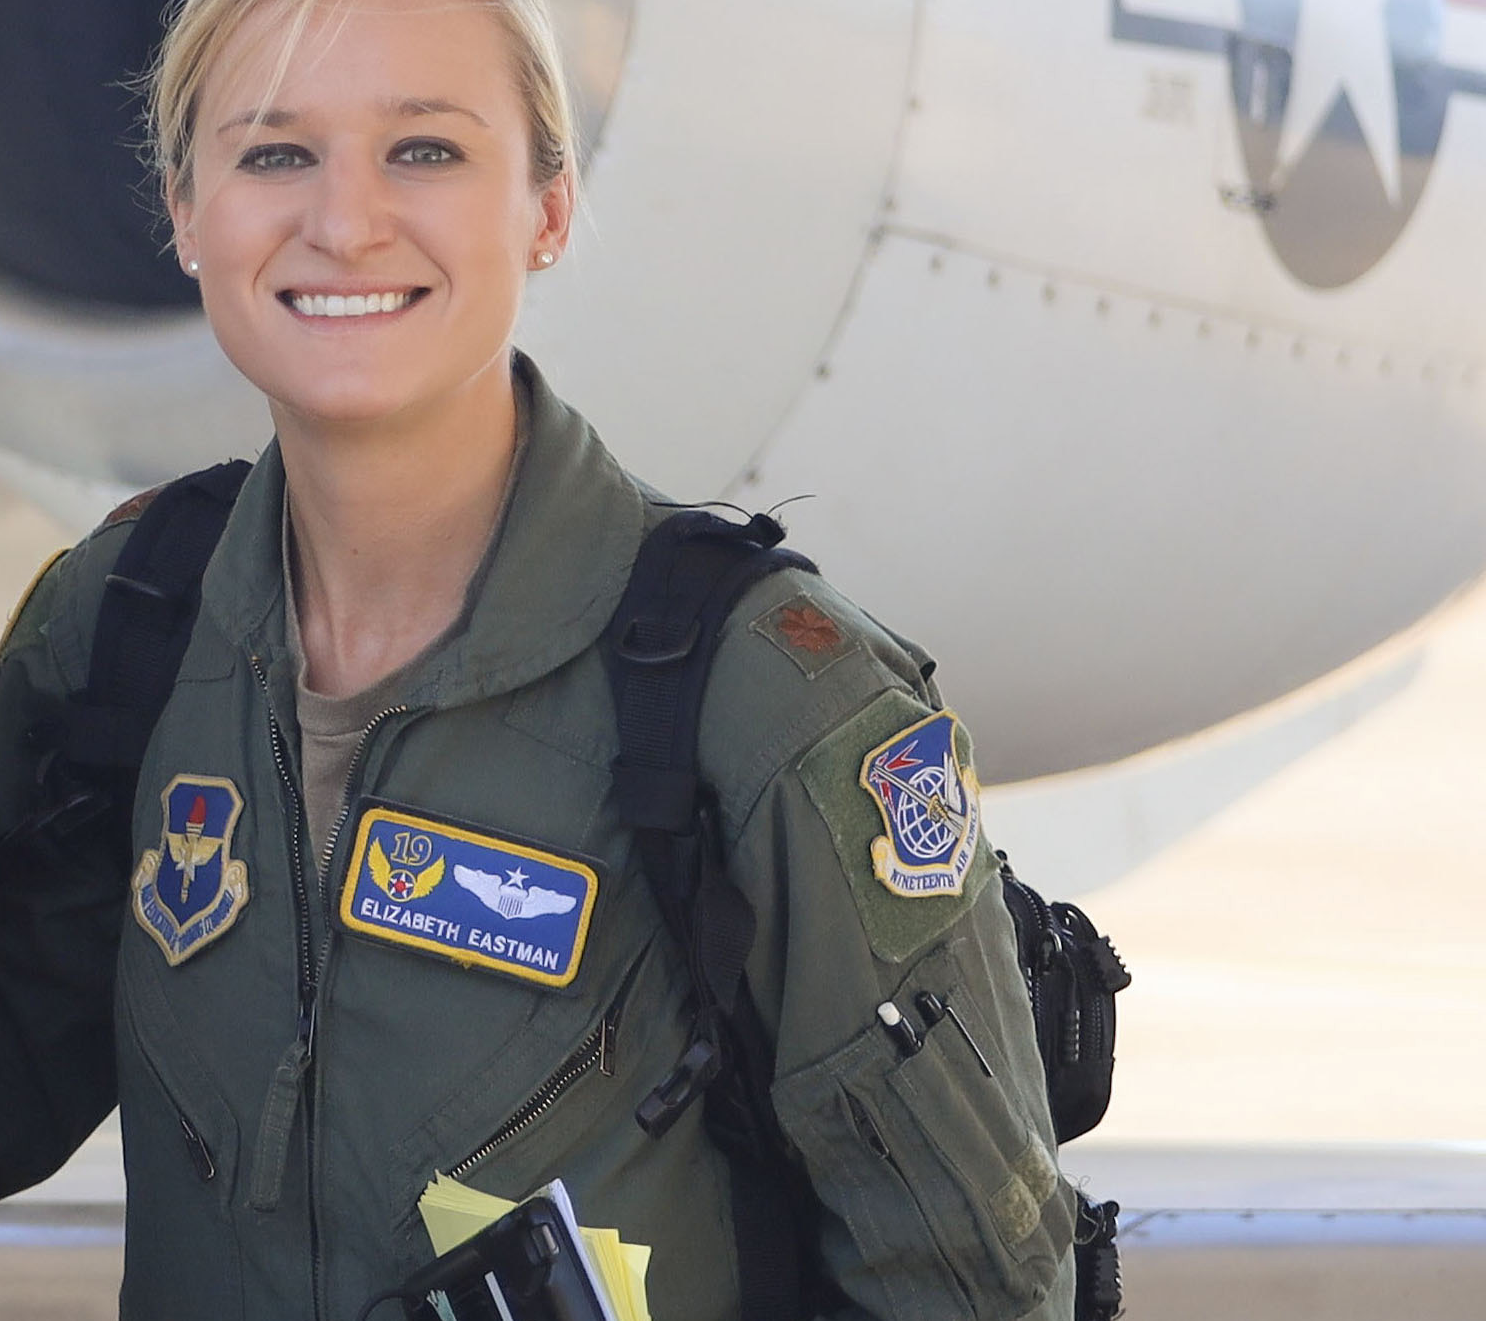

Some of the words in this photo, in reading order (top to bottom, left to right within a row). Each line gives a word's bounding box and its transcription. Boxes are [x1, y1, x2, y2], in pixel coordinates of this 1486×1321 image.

[390, 832, 432, 866] 19
[890, 869, 955, 891] NINETEENTH
[955, 850, 970, 877] AIR
[360, 897, 461, 942] ELIZABETH
[468, 933, 560, 970] EASTMAN
